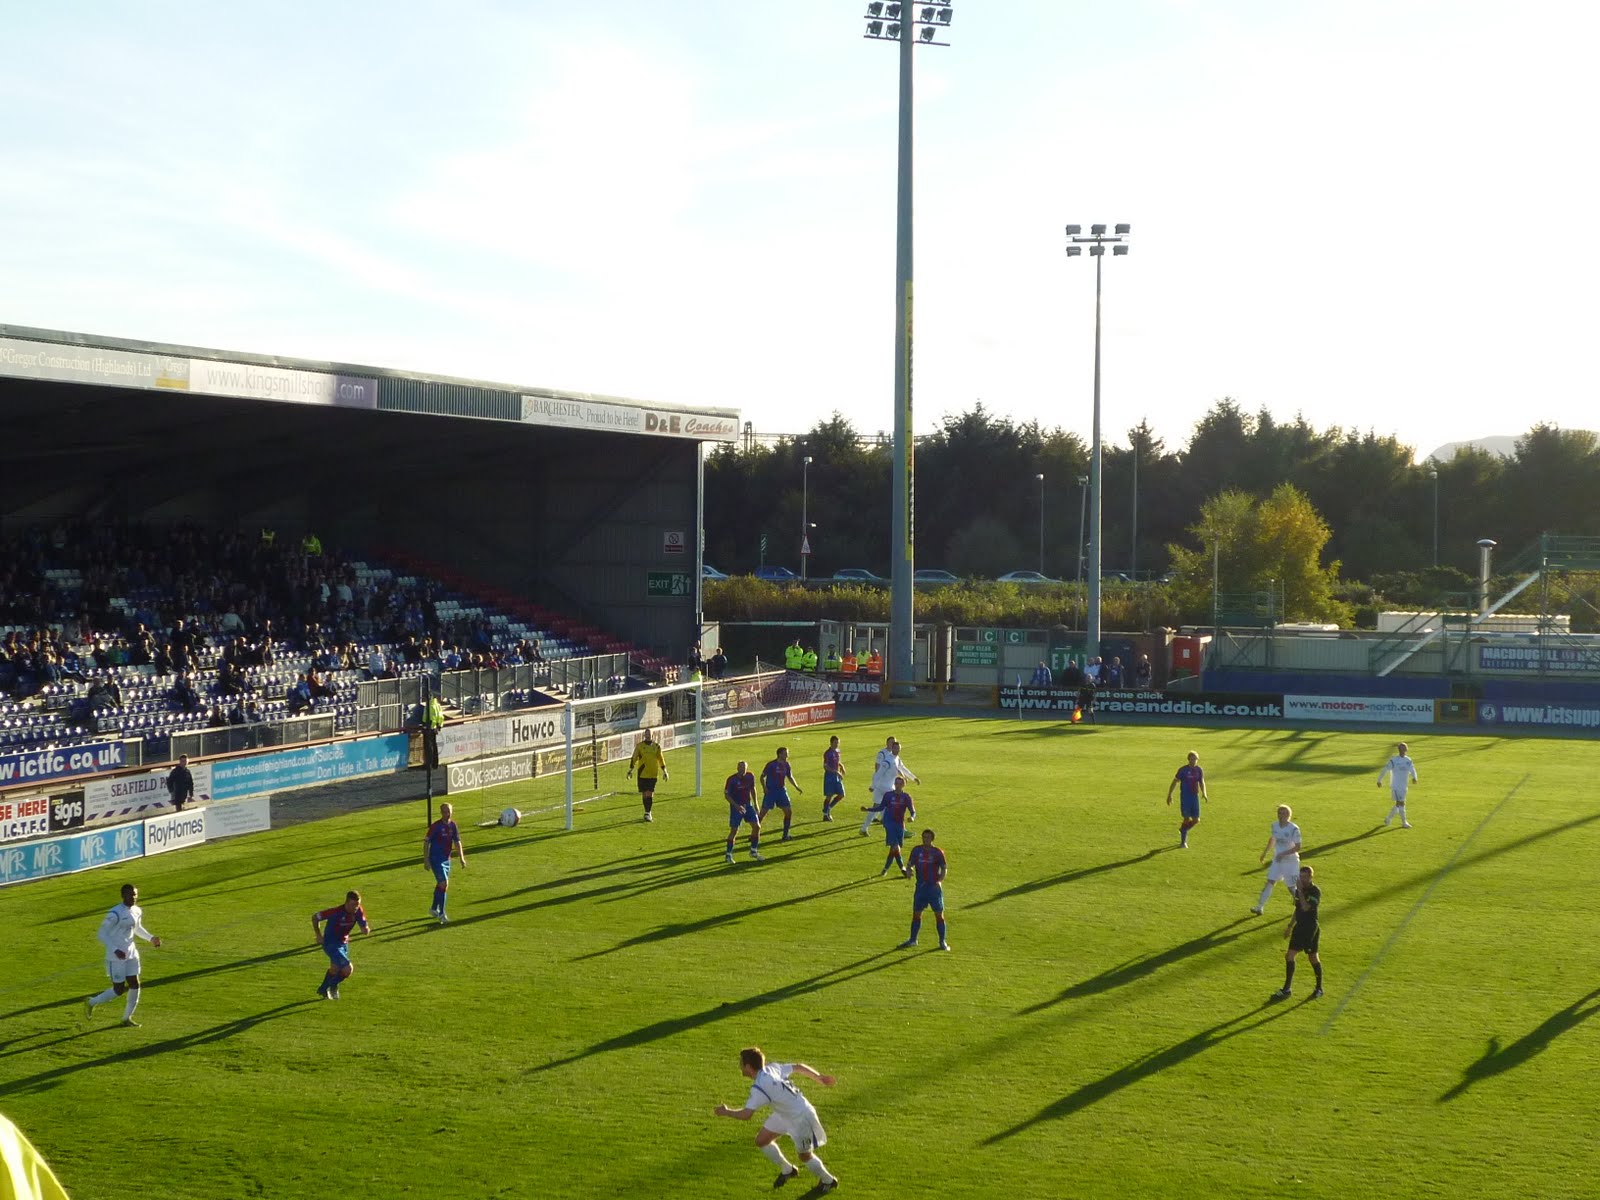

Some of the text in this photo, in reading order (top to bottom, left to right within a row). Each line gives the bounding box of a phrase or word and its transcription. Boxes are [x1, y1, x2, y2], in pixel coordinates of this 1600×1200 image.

[38, 351, 90, 372] Construction
[91, 357, 137, 378] (Highlands)
[138, 362, 151, 376] Ltd
[534, 399, 584, 420] BARCHESTER
[586, 409, 606, 425] Proud
[607, 411, 614, 424] to
[614, 412, 622, 425] be
[645, 413, 734, 434] D&E Coaches
[648, 579, 670, 589] EXIT
[984, 631, 993, 642] C
[1010, 631, 1019, 642] C
[1483, 648, 1558, 661] MACDOUGLL
[789, 680, 880, 693] TARTAN TAXIS
[1000, 688, 1024, 696] Just
[1136, 692, 1164, 700] click
[838, 692, 859, 702] 777
[786, 707, 833, 726] flybe.com flybe.com
[1000, 697, 1282, 717] www.mcraeanddick.co.uk
[1289, 701, 1432, 713] www.motors-north.co.uk
[512, 718, 555, 744] Hawco
[317, 764, 336, 779] Don't
[338, 762, 354, 776] Hide
[364, 757, 378, 770] Talk
[380, 751, 400, 768] about
[465, 764, 510, 788] Clydesdale
[512, 759, 532, 777] Bank
[111, 778, 157, 798] SEAFIELD
[17, 799, 47, 818] HERE
[54, 801, 82, 826] signs
[148, 818, 203, 846] RoyHomes
